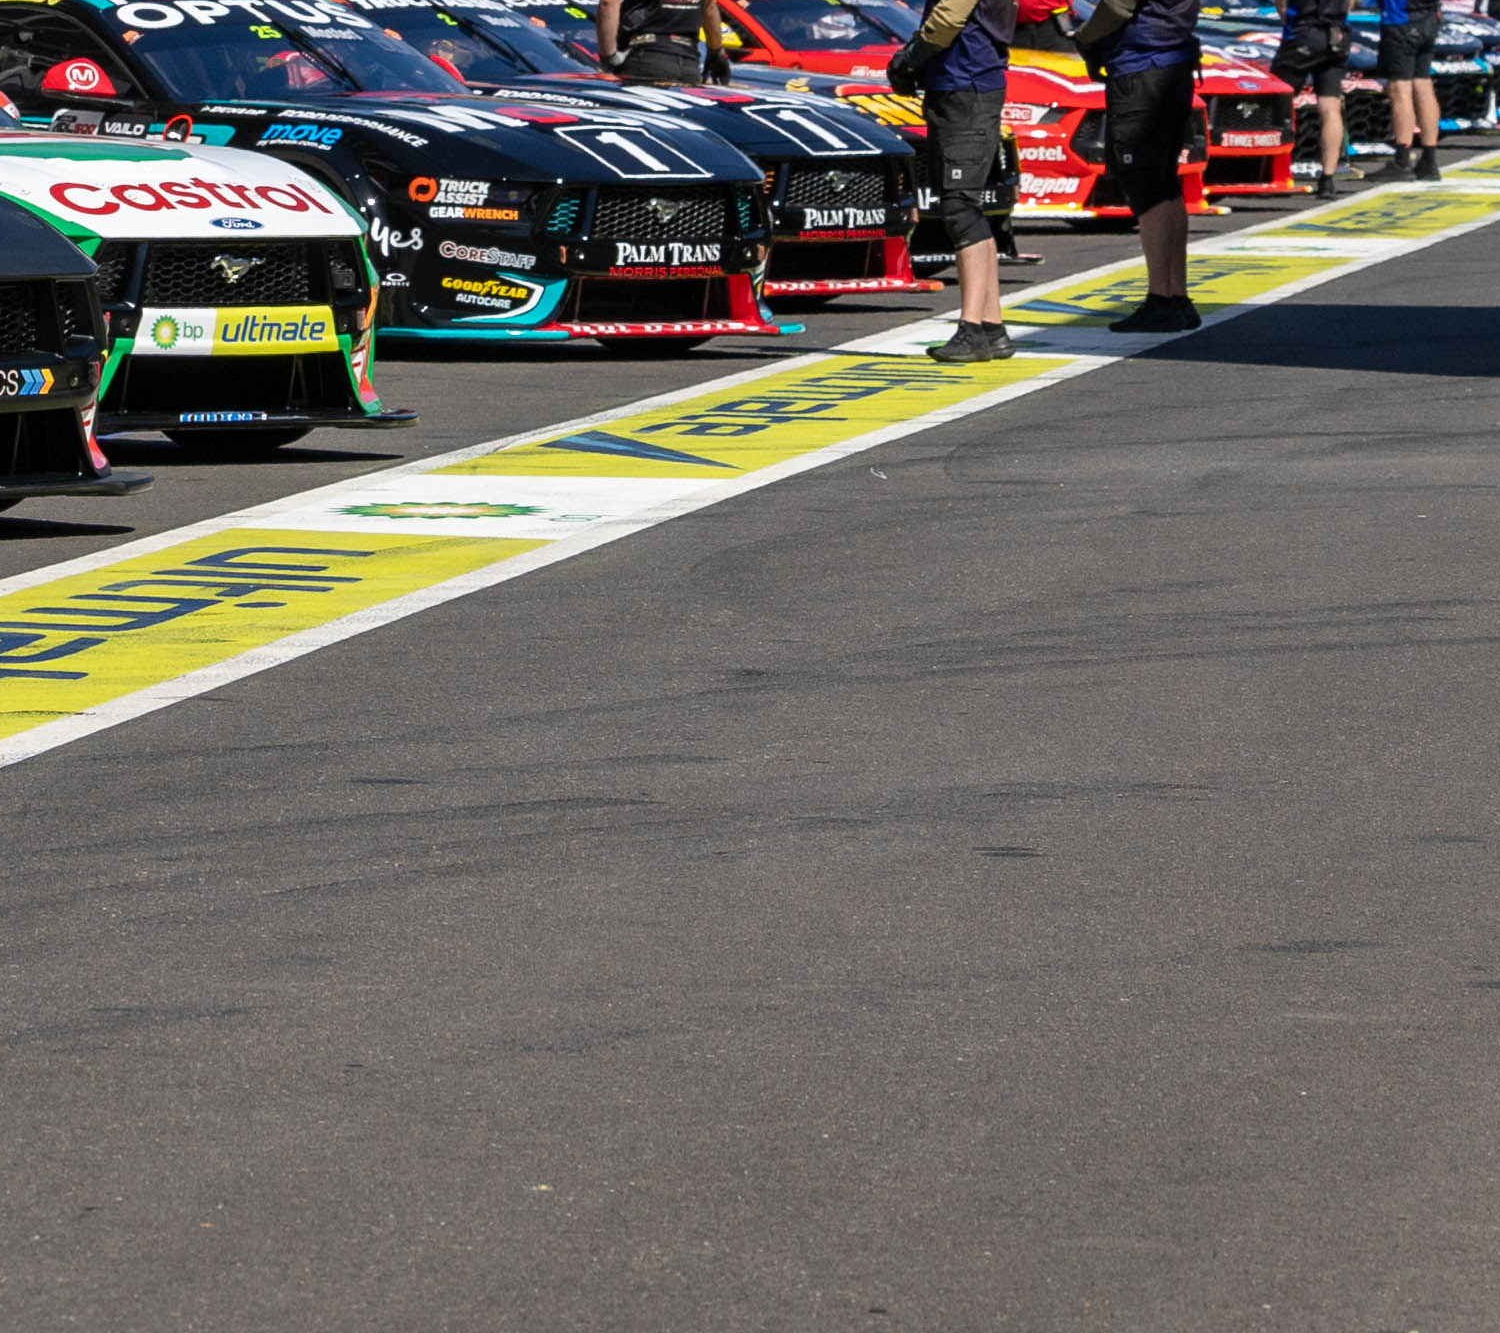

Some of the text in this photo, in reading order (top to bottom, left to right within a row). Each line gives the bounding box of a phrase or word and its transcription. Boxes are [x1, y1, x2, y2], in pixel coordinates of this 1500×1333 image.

[116, 0, 375, 30] OPTUS
[249, 25, 283, 40] 25
[104, 121, 145, 136] VAILO
[262, 122, 344, 145] move
[440, 178, 491, 194] TRUCK
[48, 181, 334, 217] Castrol
[434, 191, 489, 207] ASSIST
[429, 205, 520, 221] GEARWRENCH
[804, 207, 886, 229] PALM TRANS
[370, 216, 425, 257] yes
[617, 241, 722, 267] PALM TRANS
[441, 276, 528, 300] GOODYEAR
[456, 294, 512, 309] AUTOCARE
[183, 320, 204, 343] bp
[221, 313, 326, 344] ultimate
